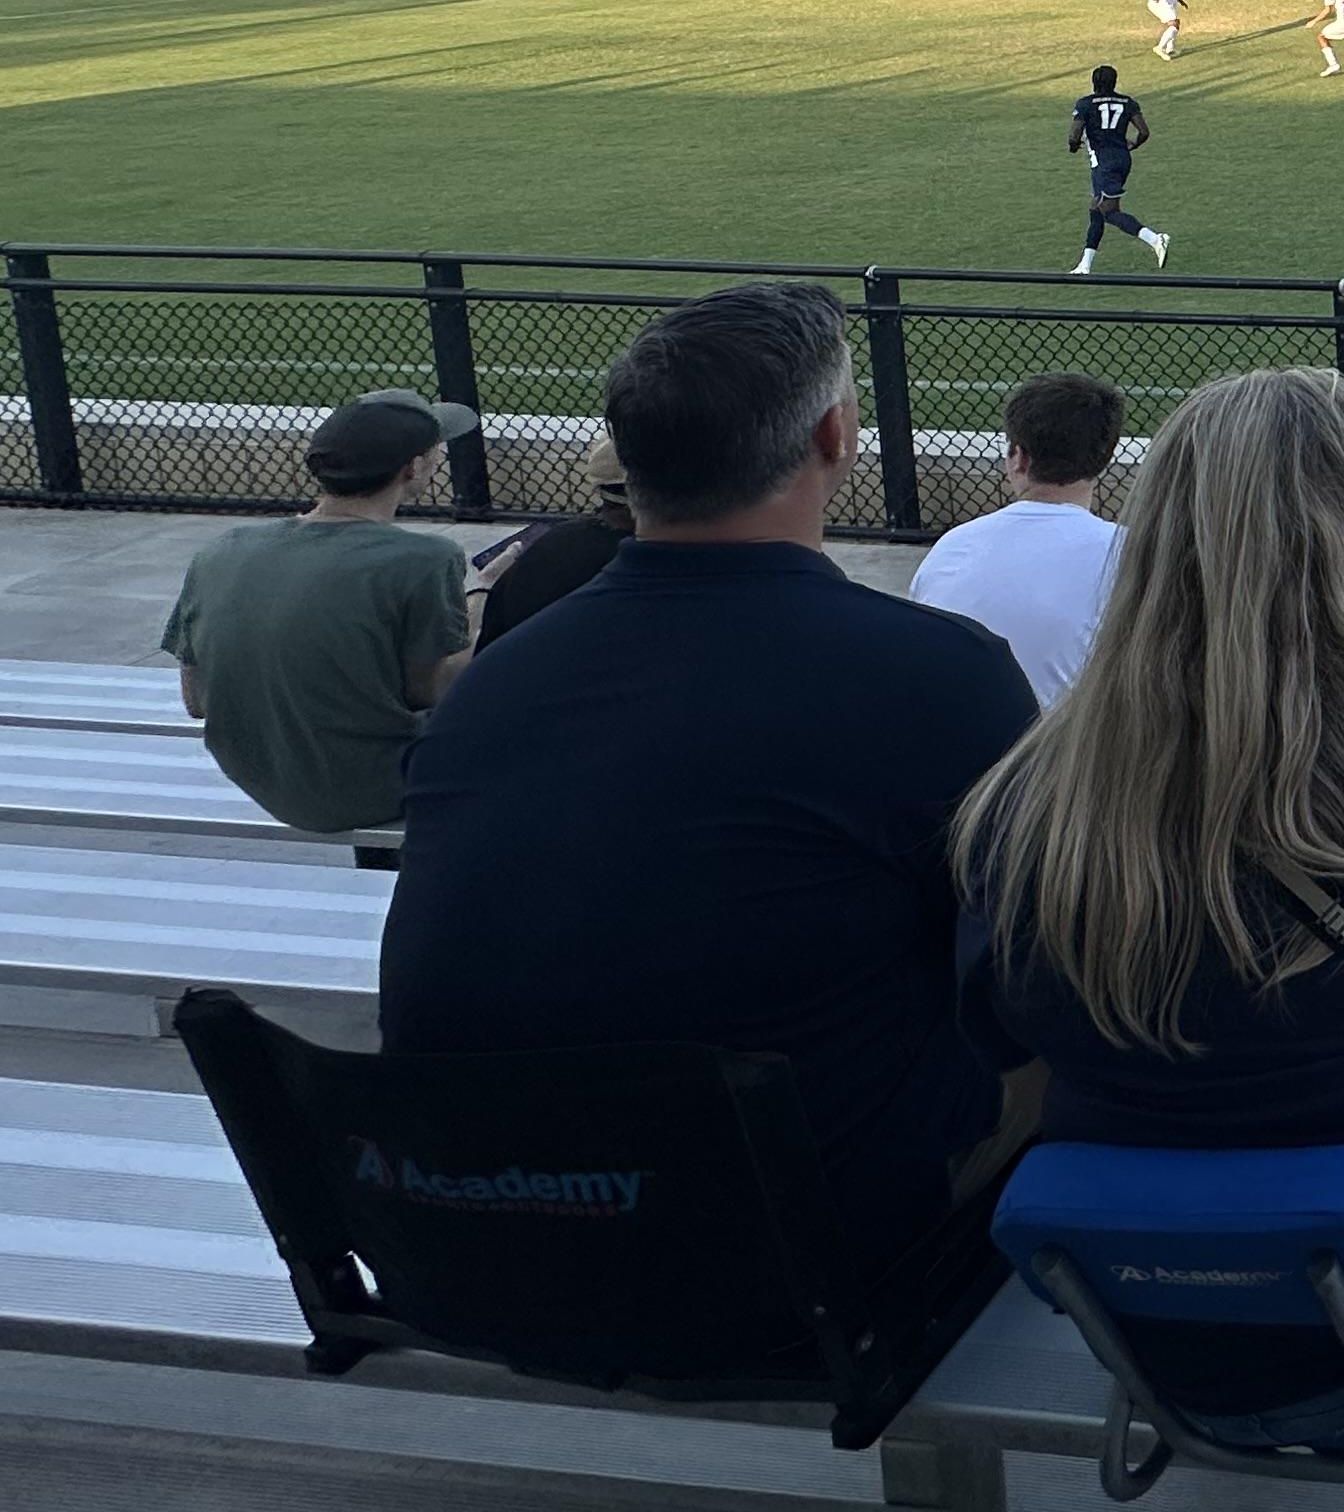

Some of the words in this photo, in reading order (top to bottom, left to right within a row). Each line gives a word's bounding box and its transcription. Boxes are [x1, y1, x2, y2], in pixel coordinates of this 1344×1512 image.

[1098, 103, 1124, 129] 17
[401, 1157, 642, 1213] Academy
[1154, 1266, 1281, 1284] Academy
